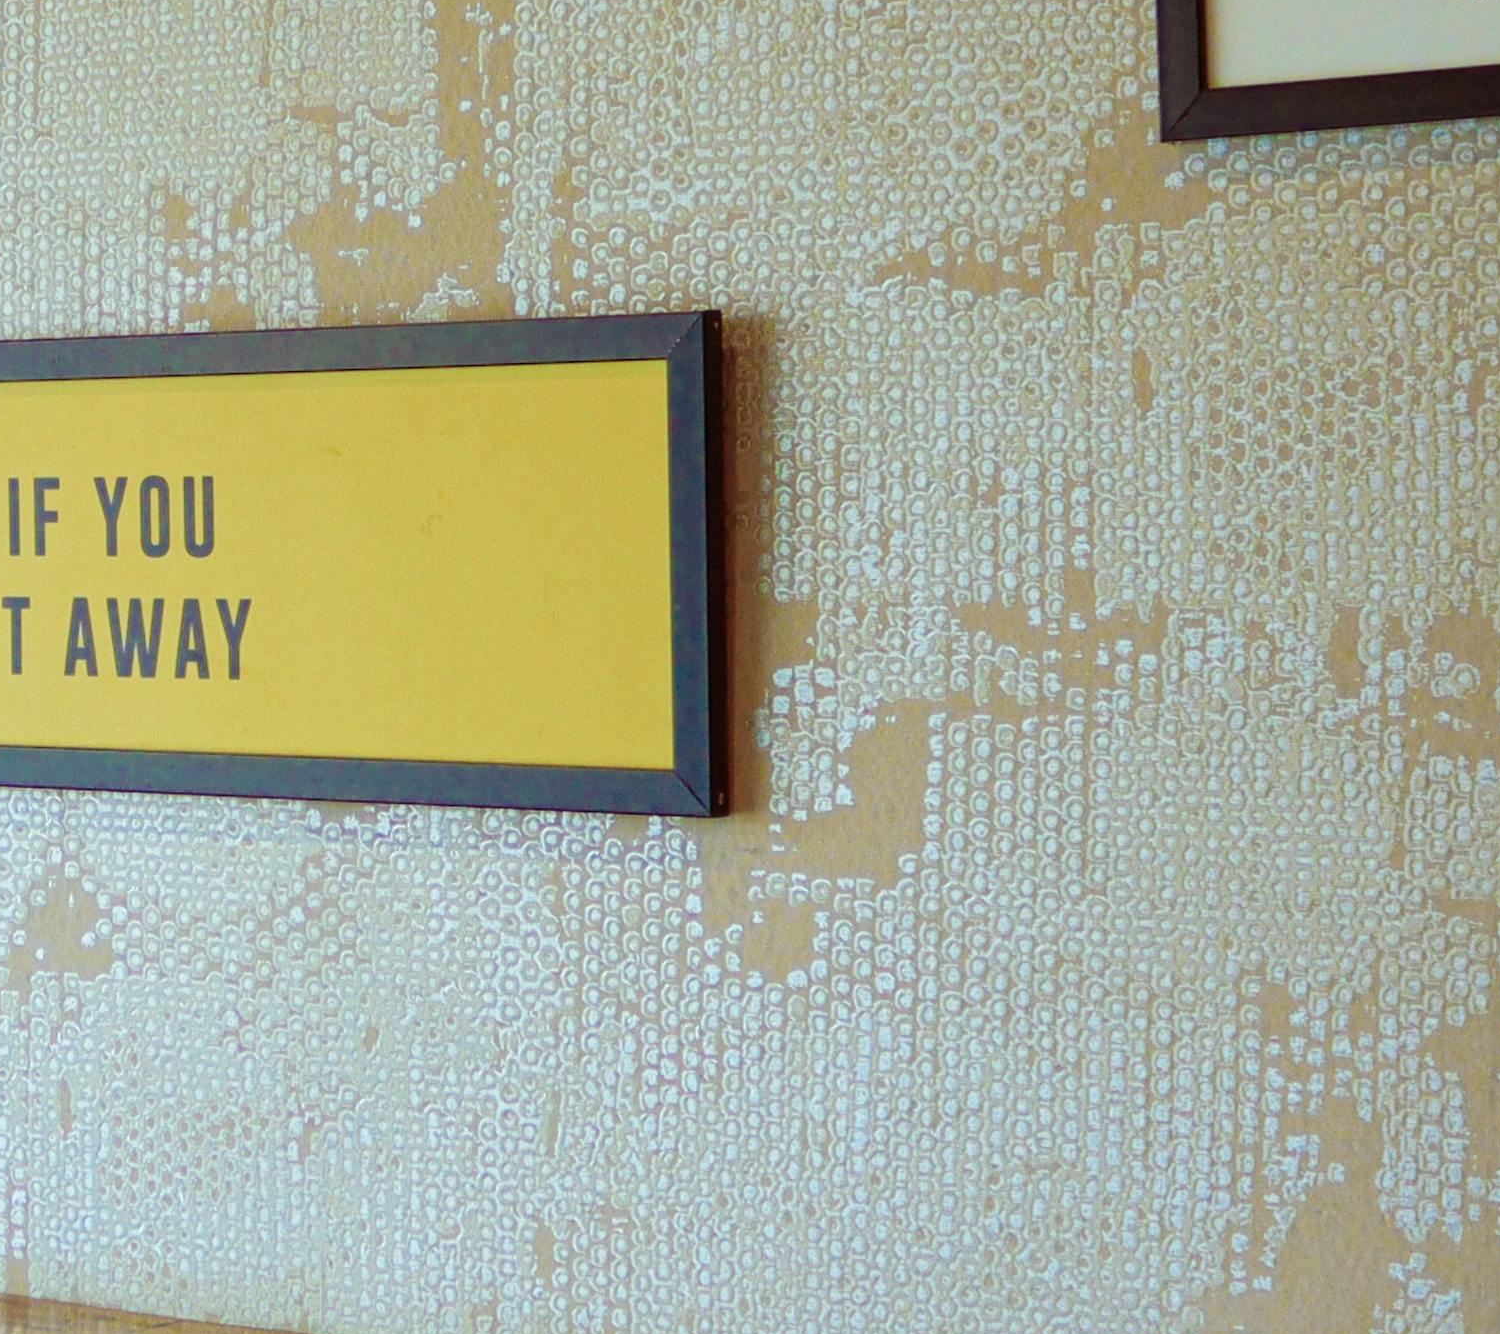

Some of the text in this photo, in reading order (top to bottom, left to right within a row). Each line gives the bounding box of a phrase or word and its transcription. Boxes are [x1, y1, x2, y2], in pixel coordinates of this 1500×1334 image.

[6, 475, 62, 558] IF
[92, 473, 216, 560] YOU
[62, 595, 253, 682] AWAY
